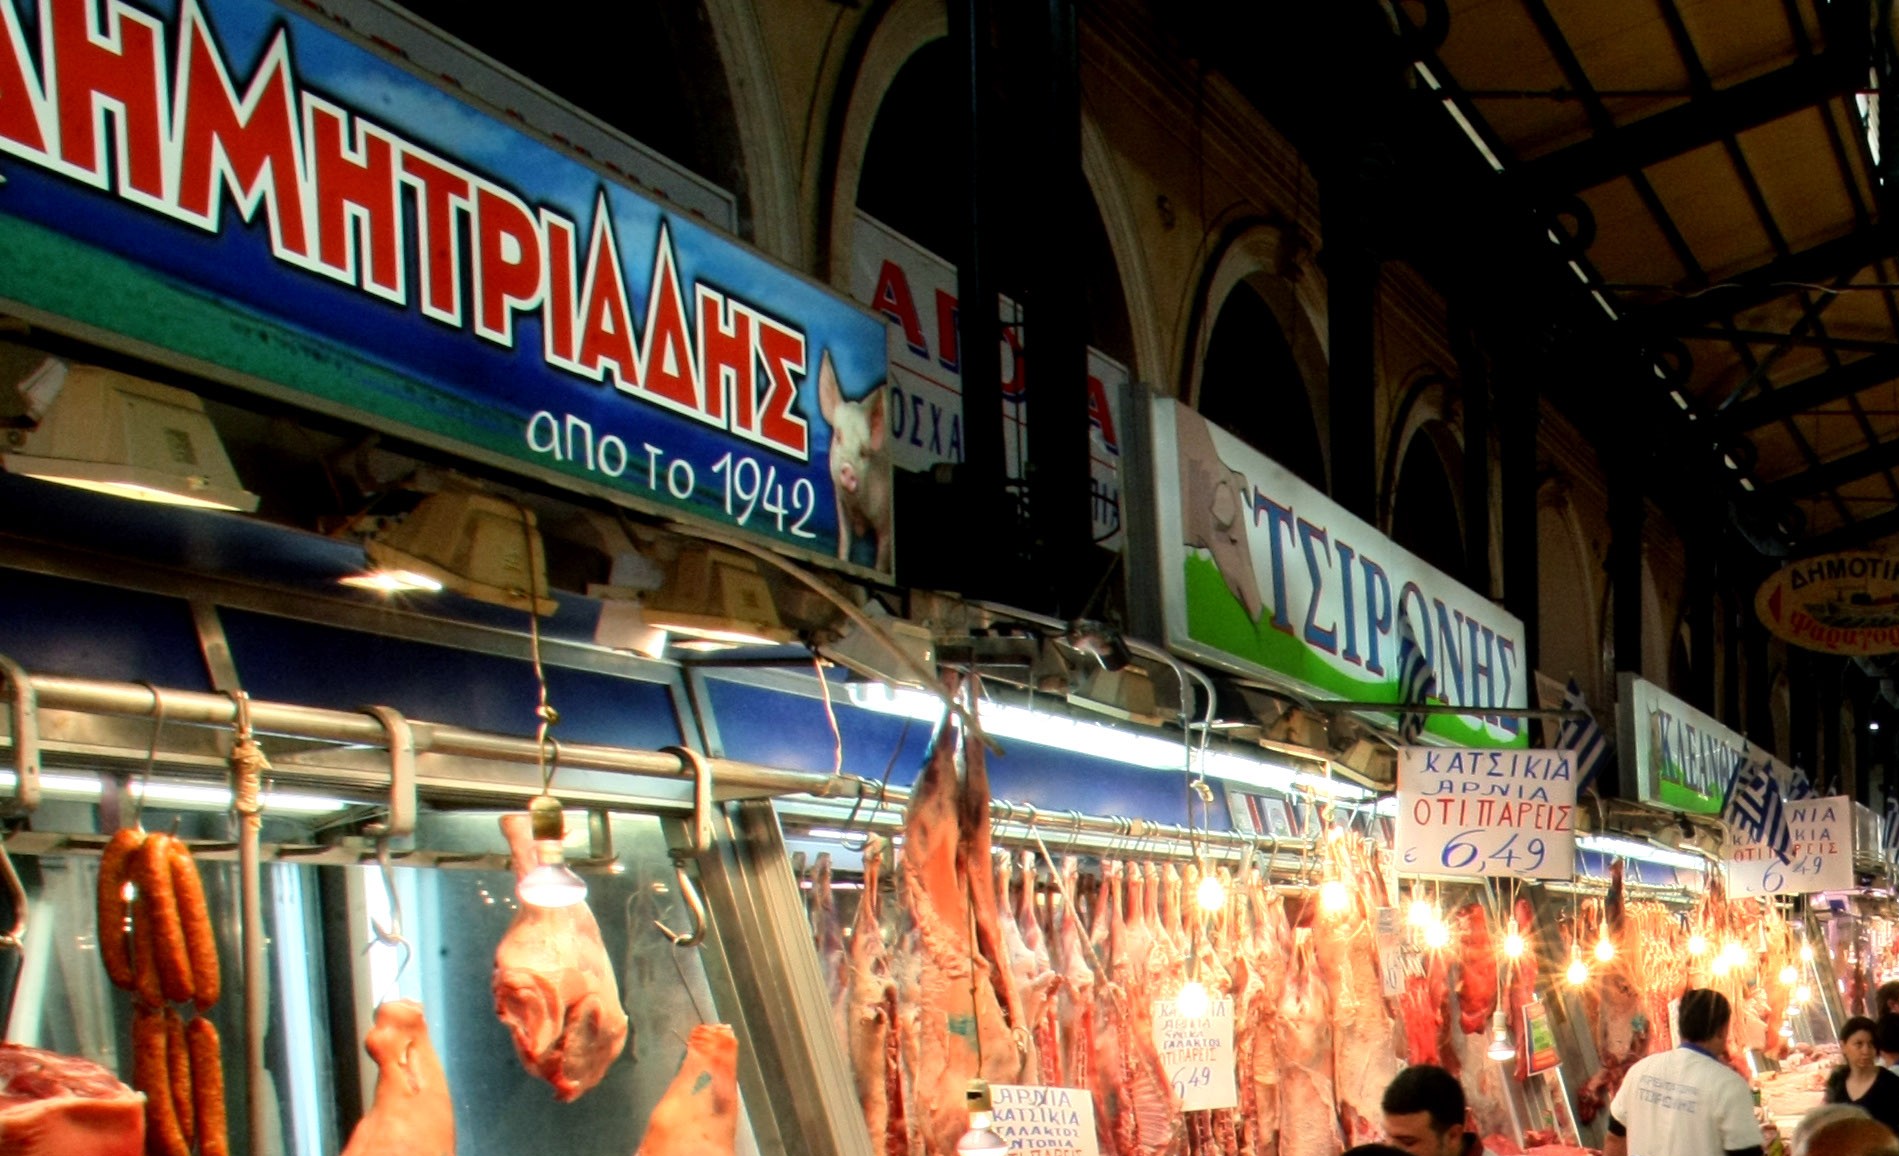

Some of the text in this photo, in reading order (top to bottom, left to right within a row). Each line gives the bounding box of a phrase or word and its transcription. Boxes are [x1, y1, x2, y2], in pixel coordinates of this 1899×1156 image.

[711, 454, 818, 539] 1942
[1419, 750, 1570, 781] ΚΑΤΣΙΚΙΑ
[1421, 779, 1549, 803] ΑΡΝΙΑ
[1476, 799, 1572, 831] ΠΑΡΕΙΣ
[1441, 829, 1546, 873] 6,49
[993, 1087, 1072, 1108] ΑΡΝΙΑ
[992, 1107, 1080, 1126] ΚΑΤΣΙΚΙΑ
